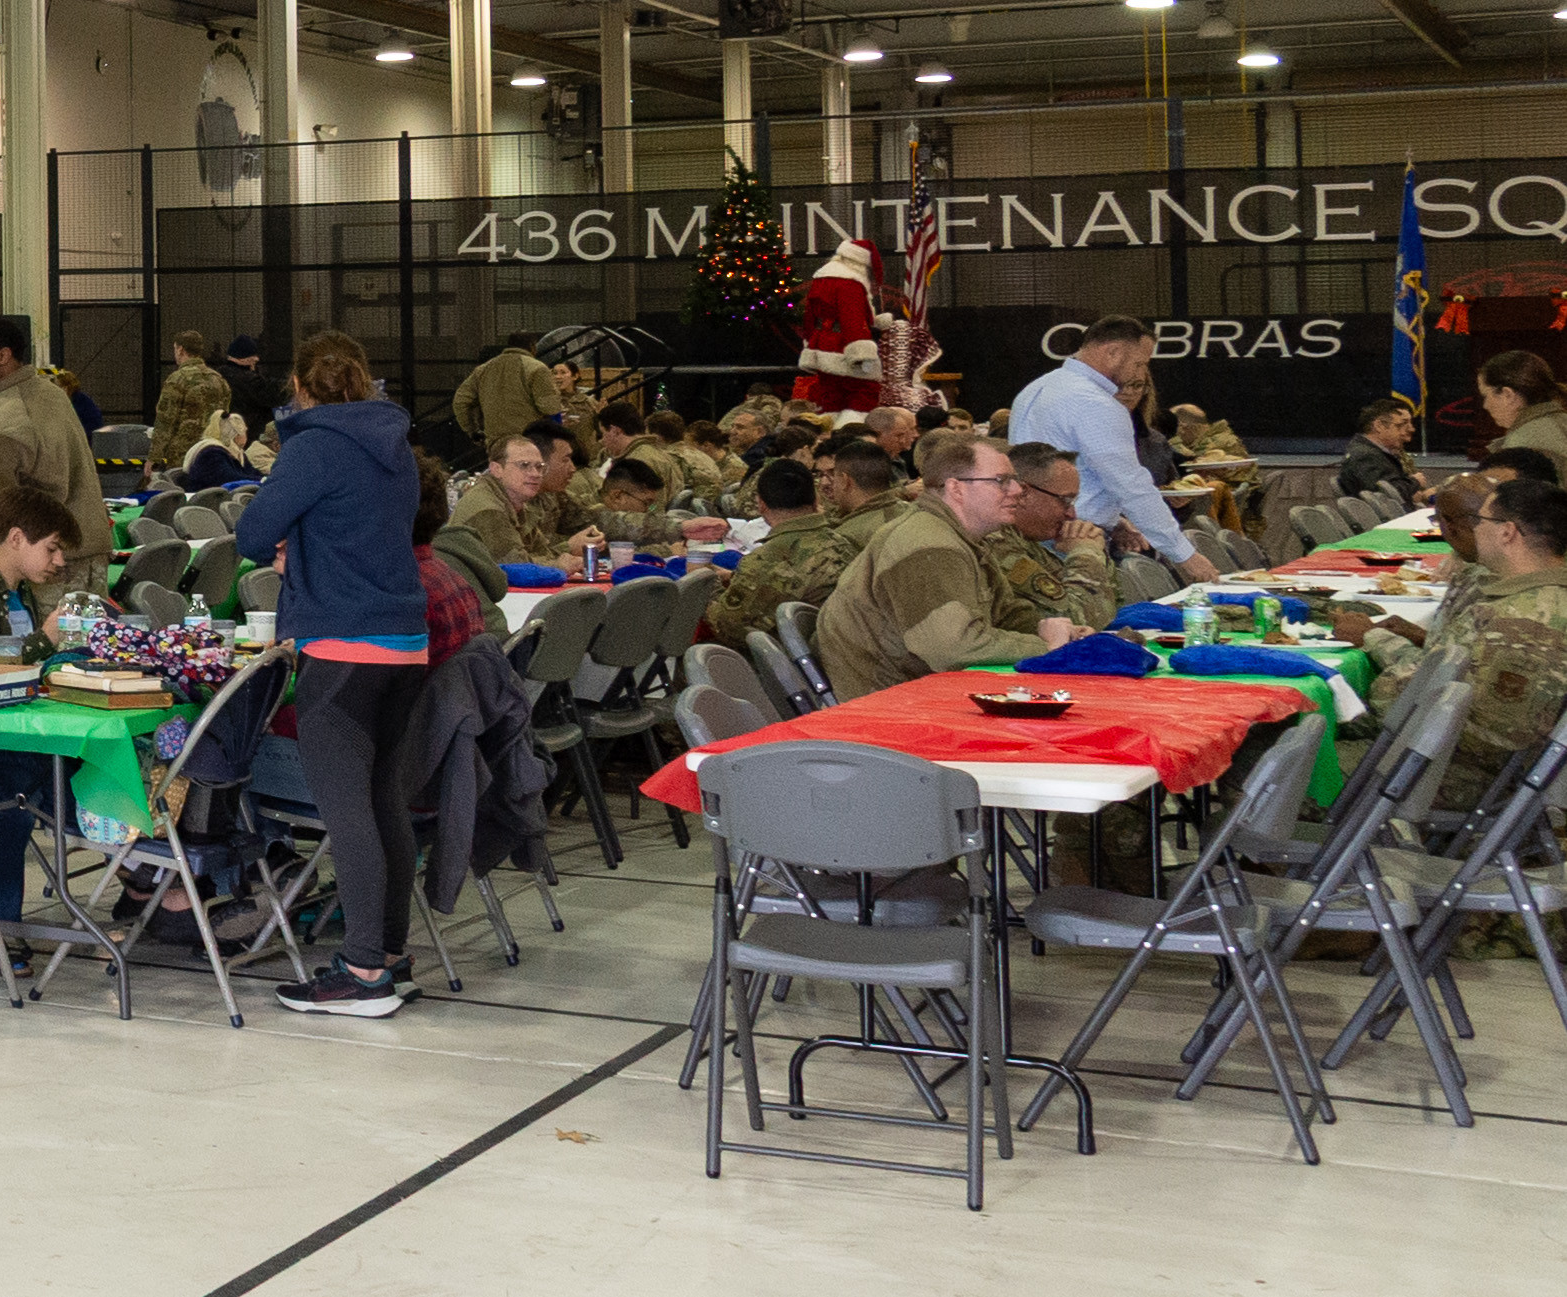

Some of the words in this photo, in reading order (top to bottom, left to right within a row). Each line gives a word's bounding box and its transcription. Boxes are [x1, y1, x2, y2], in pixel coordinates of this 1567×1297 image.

[457, 208, 618, 264] 436
[645, 180, 1377, 260] MINTENANCE
[1041, 319, 1346, 361] CBRAS
